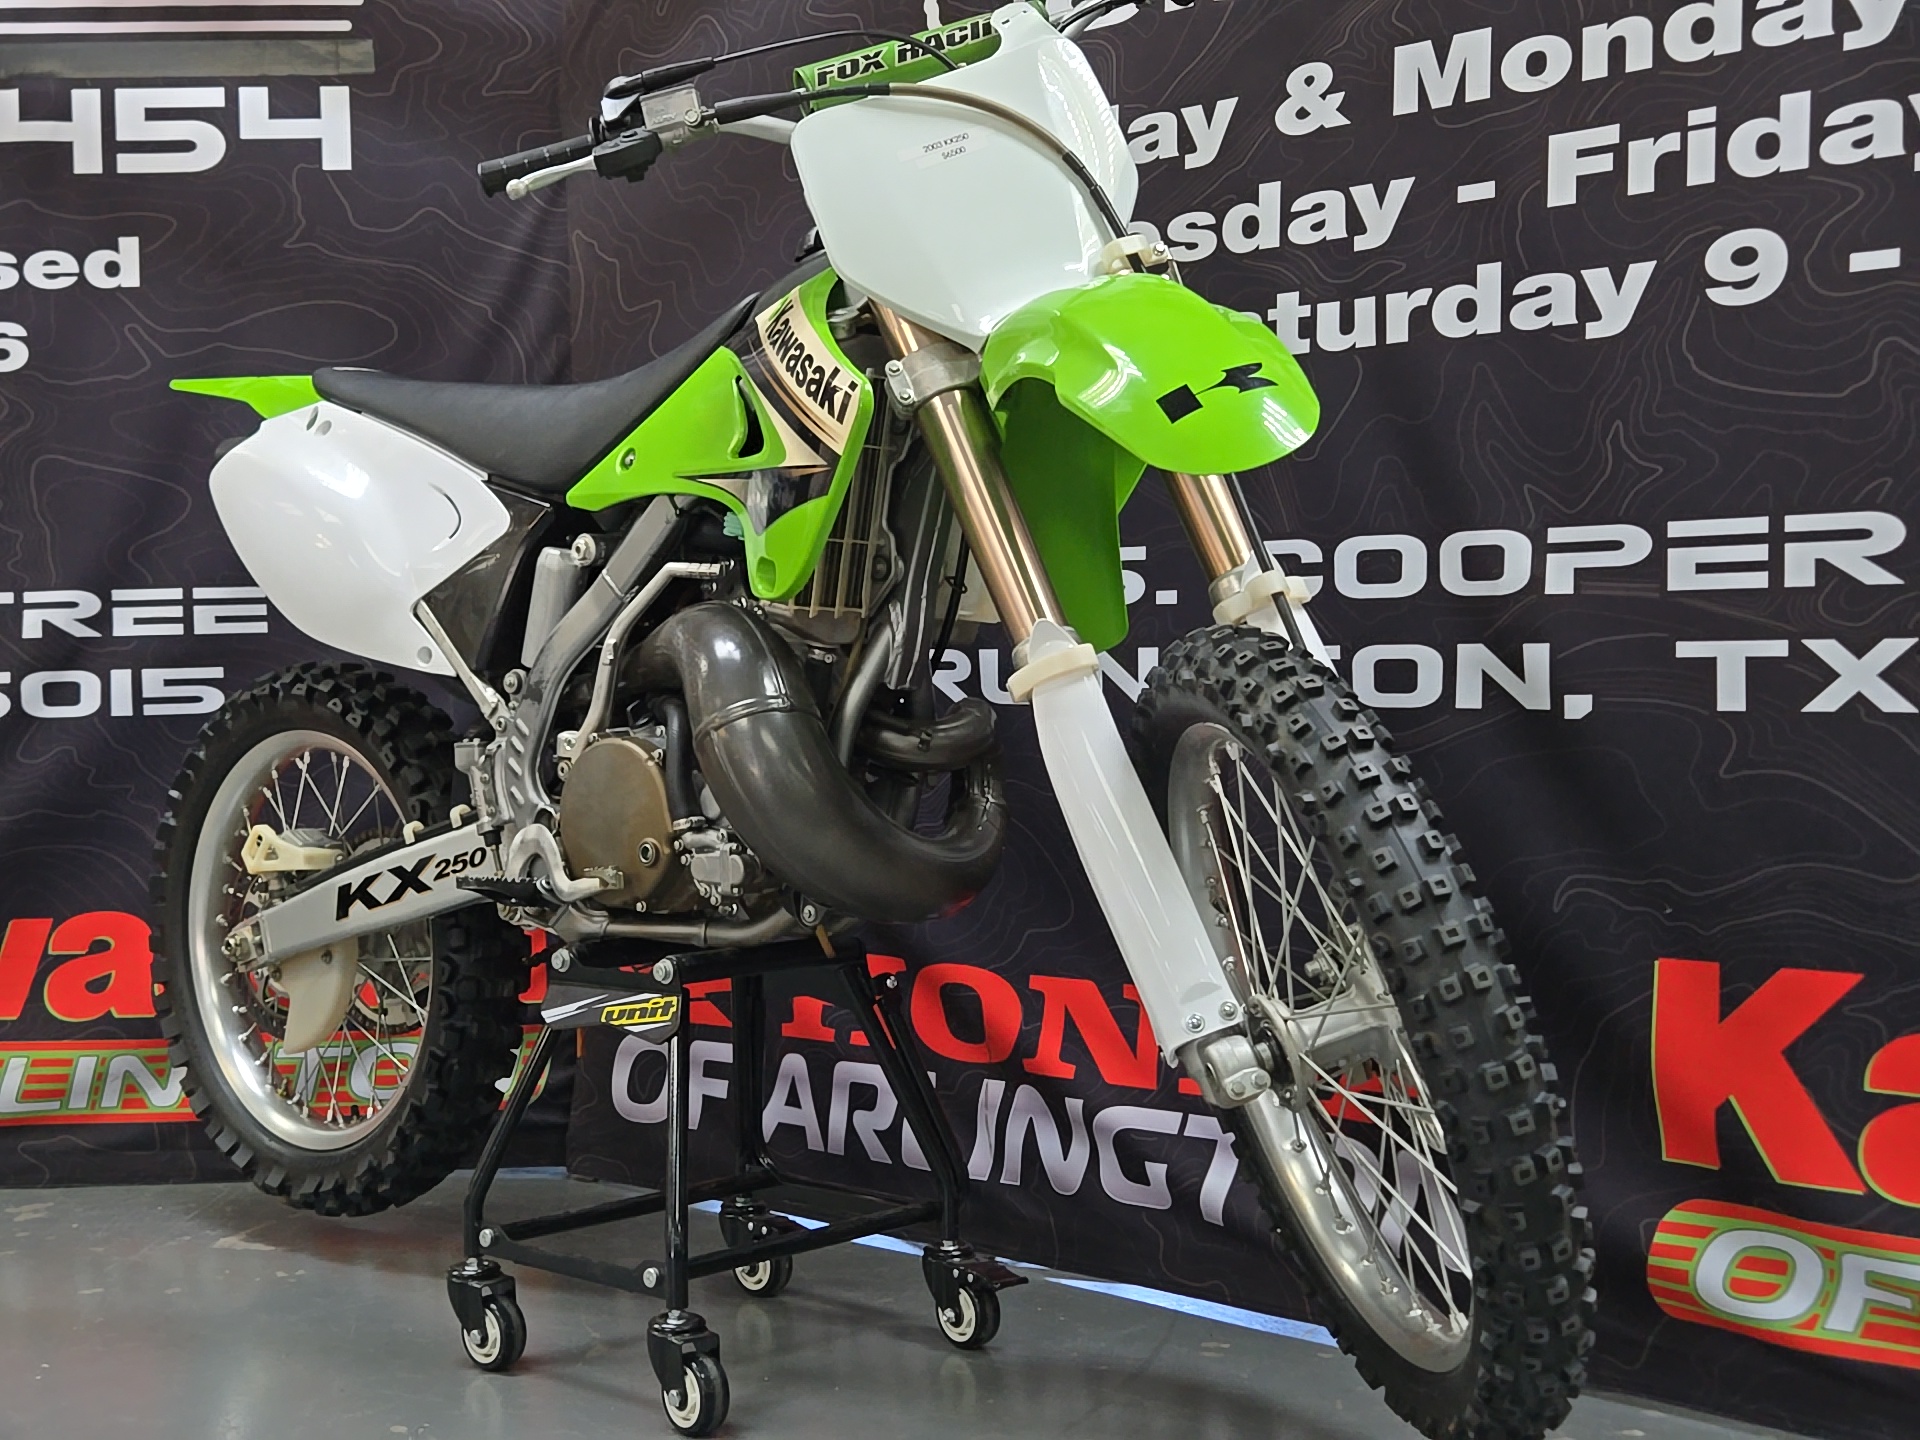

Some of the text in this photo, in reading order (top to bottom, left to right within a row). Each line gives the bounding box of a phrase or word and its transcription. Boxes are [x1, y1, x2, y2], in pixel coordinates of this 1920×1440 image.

[815, 48, 888, 86] FOX
[1109, 0, 1905, 169] ay & Monday
[922, 141, 943, 153] 2003
[1547, 90, 1920, 207] Frida
[1230, 260, 1657, 356] turday
[1704, 228, 1788, 306] 9
[764, 298, 858, 426] Kawasaki
[0, 586, 269, 639] REE
[0, 667, 226, 719] 015
[1675, 637, 1919, 713] TX
[335, 846, 488, 921] KX 250
[601, 996, 677, 1025] unit
[611, 1033, 734, 1131] OF
[1695, 1229, 1920, 1333] OF
